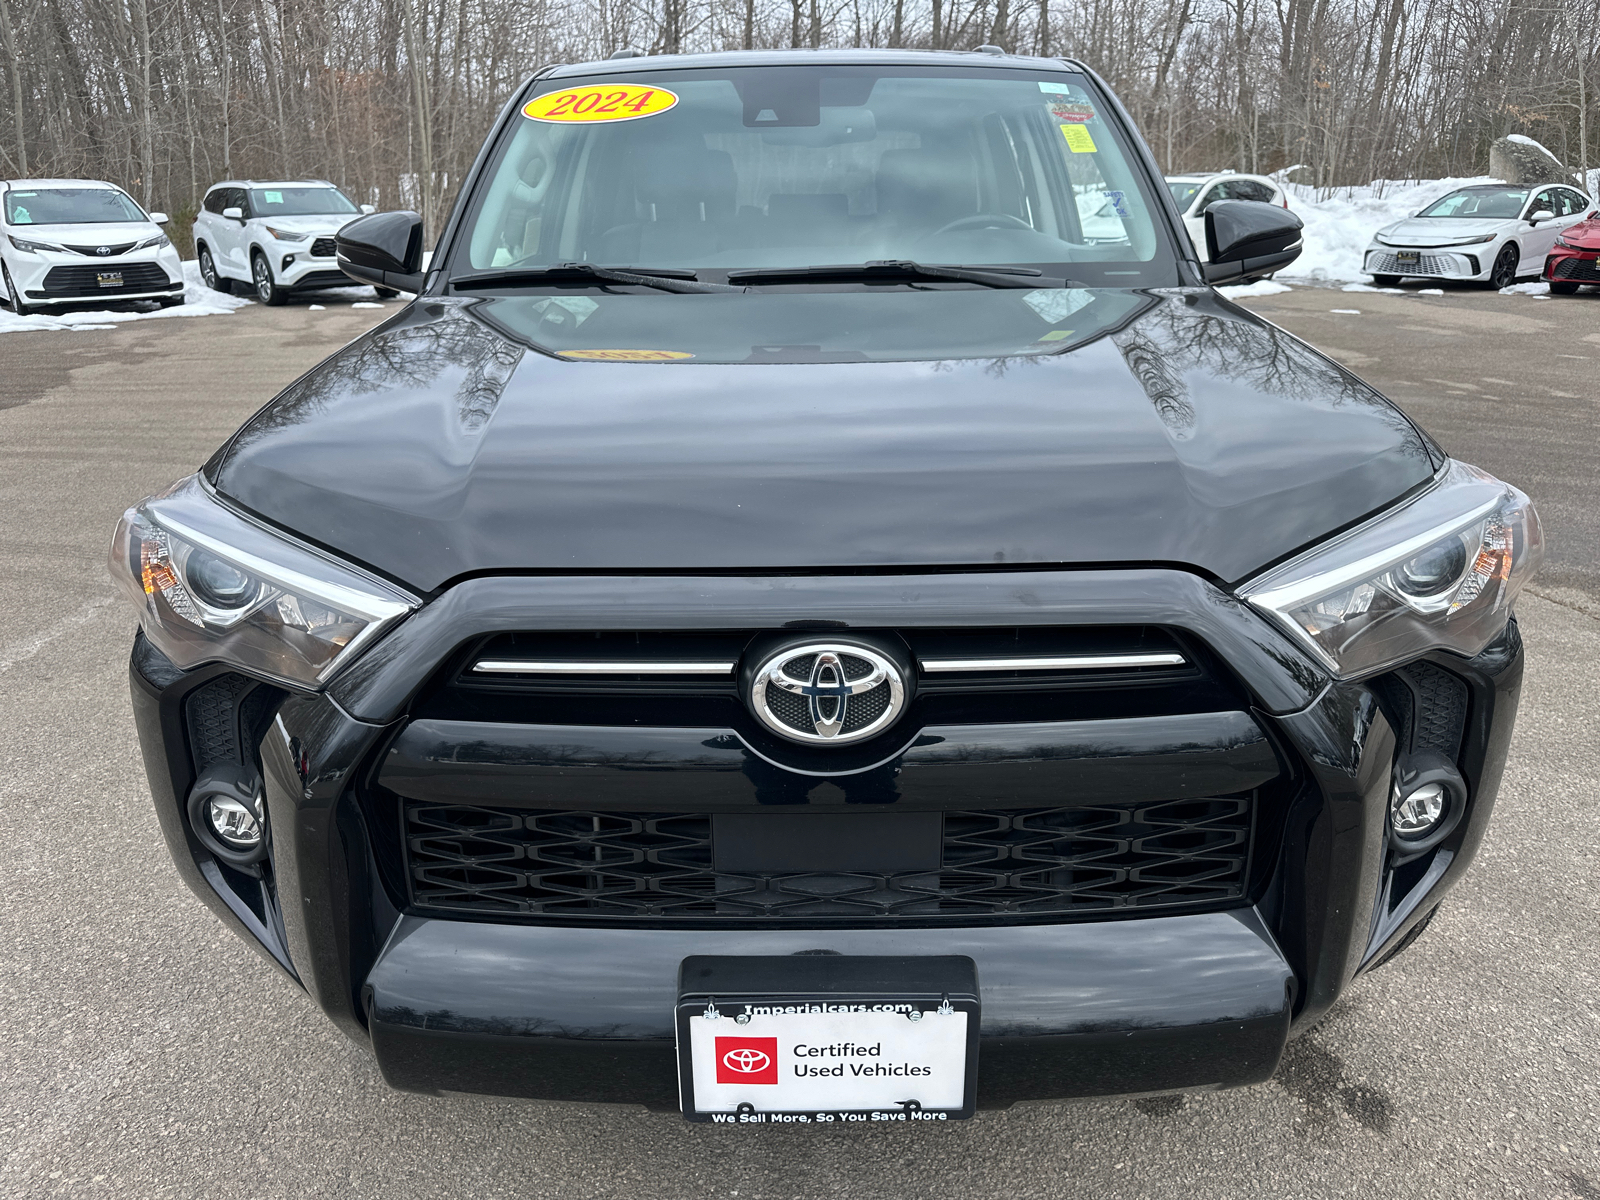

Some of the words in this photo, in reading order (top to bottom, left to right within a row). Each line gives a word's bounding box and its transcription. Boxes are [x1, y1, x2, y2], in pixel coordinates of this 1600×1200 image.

[544, 91, 654, 117] 2024
[744, 1003, 913, 1015] Imperialcars.com
[793, 1042, 881, 1057] Certified
[793, 1063, 844, 1077] Used
[849, 1062, 932, 1076] Vehicles
[711, 1113, 736, 1123] We
[739, 1112, 767, 1123] Sell
[771, 1113, 812, 1124] More,
[815, 1112, 835, 1122] So
[840, 1112, 867, 1122] You
[871, 1111, 906, 1121] Save
[911, 1111, 948, 1121] More
